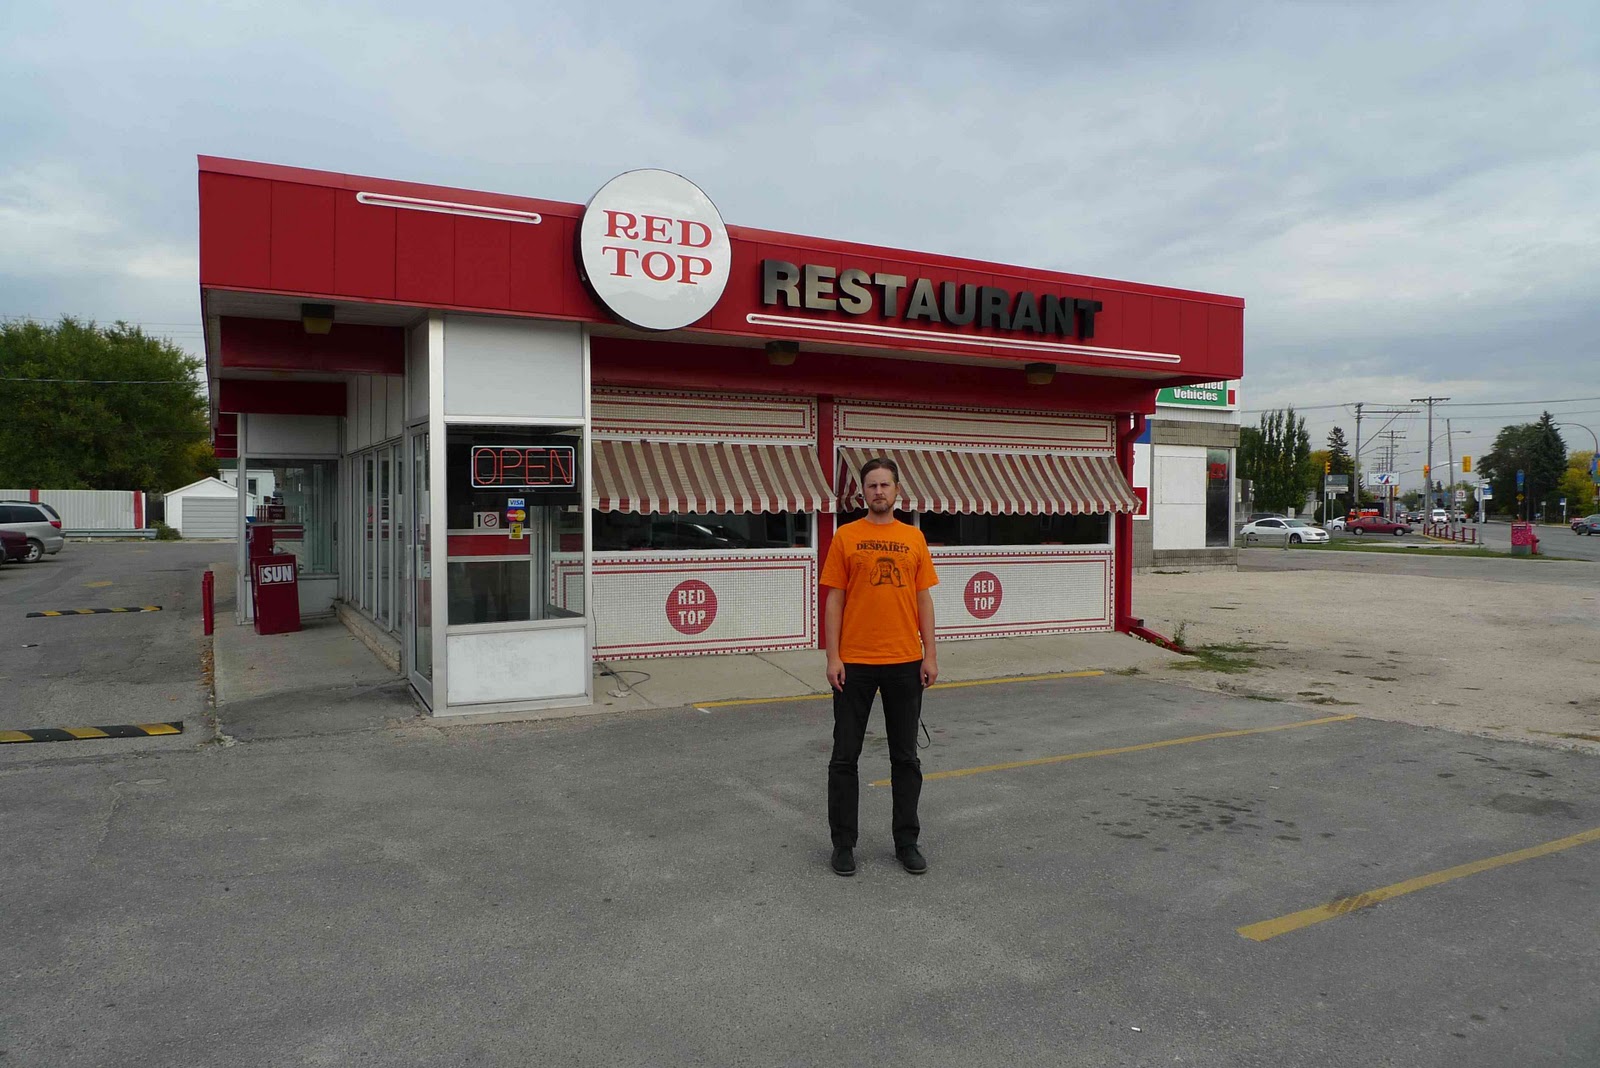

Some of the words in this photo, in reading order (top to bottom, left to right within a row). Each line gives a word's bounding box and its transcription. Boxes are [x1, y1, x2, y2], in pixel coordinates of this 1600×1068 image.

[602, 210, 713, 248] RED
[602, 246, 713, 285] TOP
[761, 258, 1103, 339] RESTAURANT
[1173, 388, 1218, 401] Vehicles
[474, 448, 572, 484] OPEN
[856, 543, 910, 554] DESPAIR!?
[264, 566, 292, 583] SUN
[974, 580, 995, 593] RED
[678, 589, 706, 605] RED
[974, 597, 995, 610] TOP
[678, 610, 706, 626] TOP
